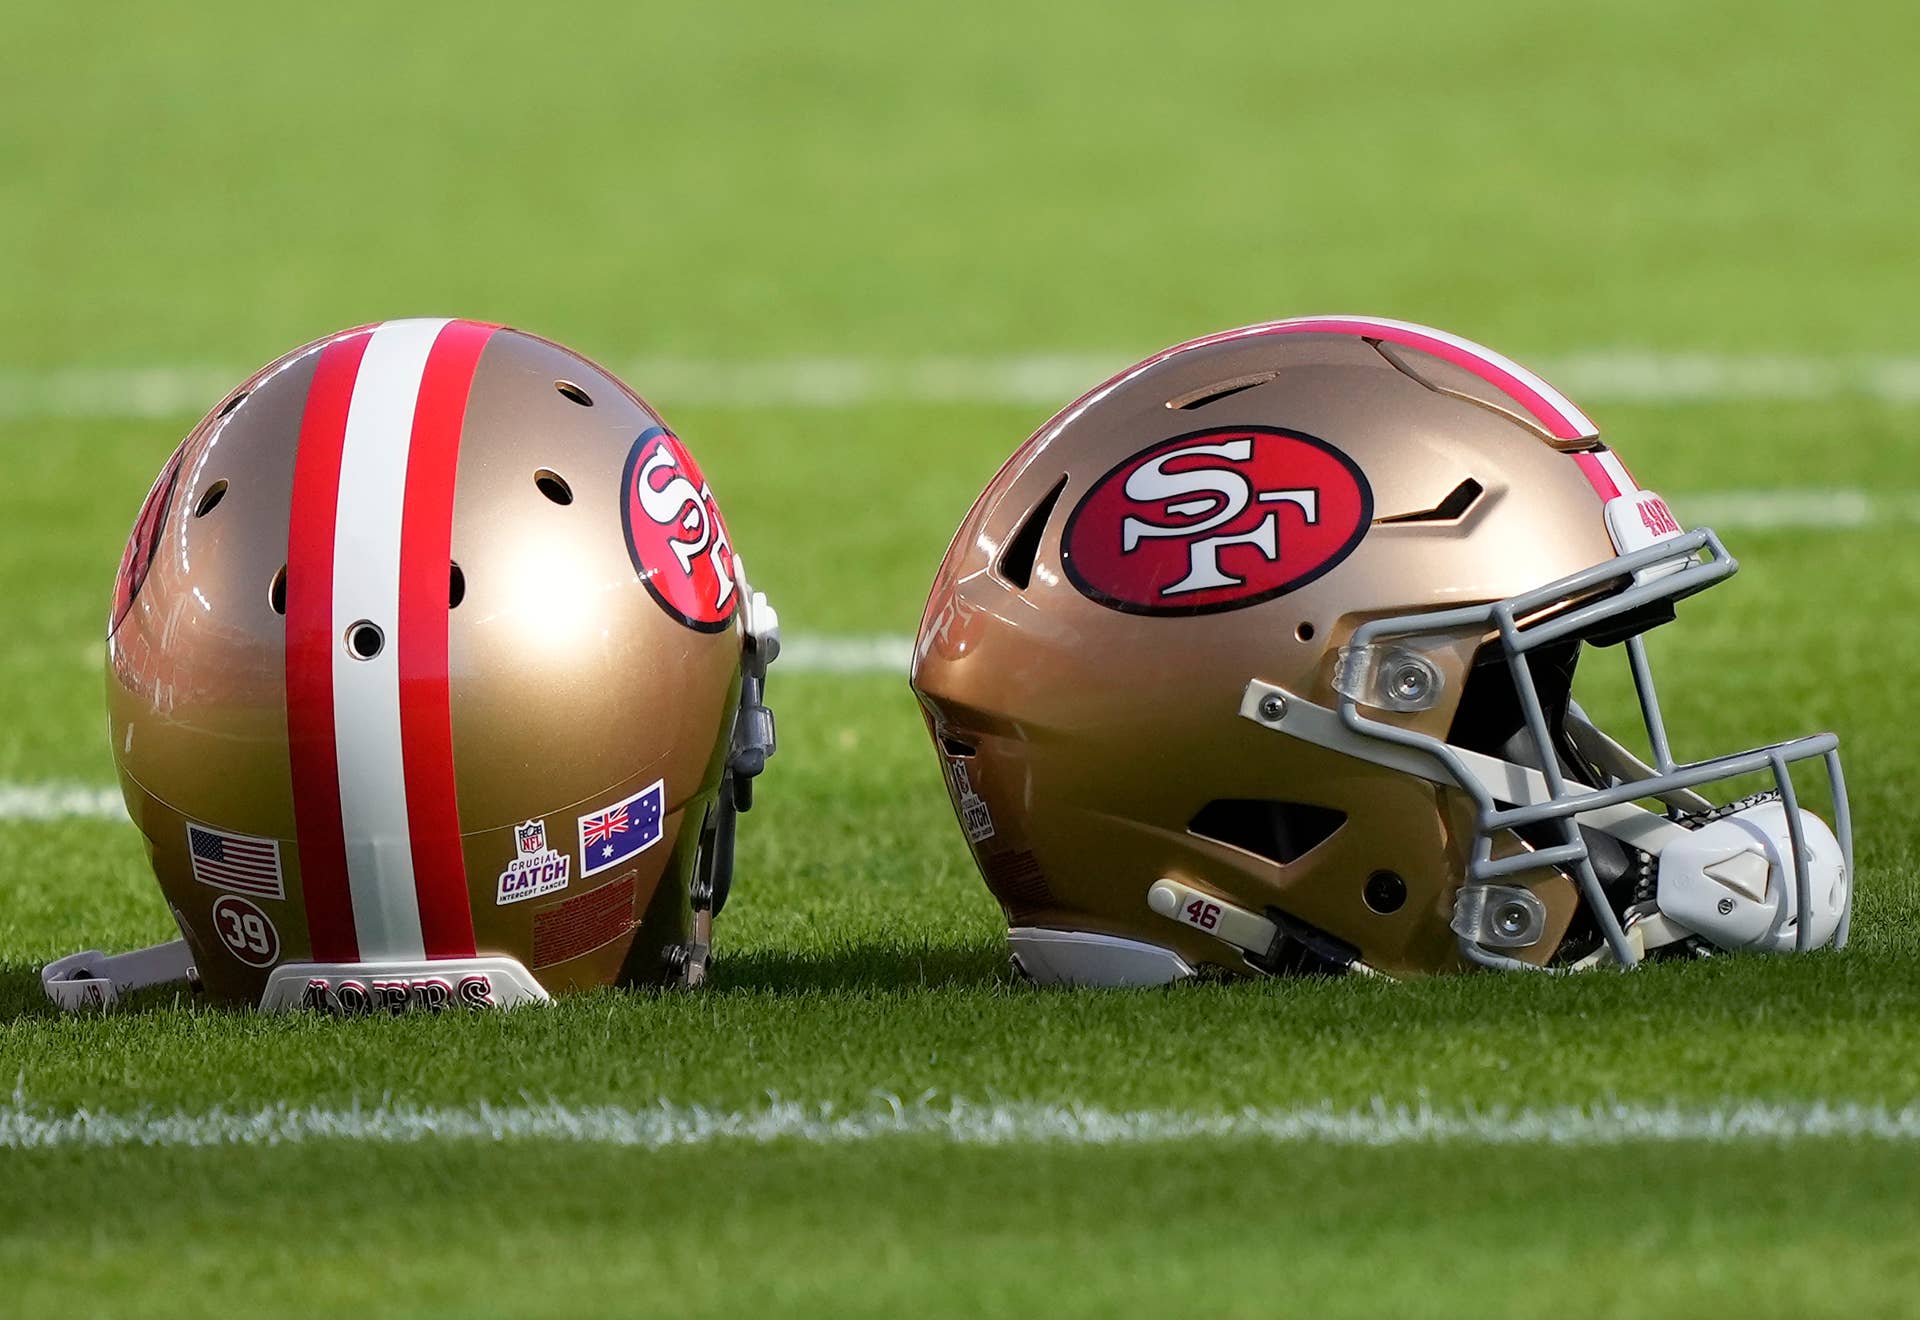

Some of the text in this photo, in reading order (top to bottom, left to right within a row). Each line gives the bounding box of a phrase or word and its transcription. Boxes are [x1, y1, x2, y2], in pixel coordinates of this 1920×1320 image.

[1123, 438, 1316, 596] SF
[522, 835, 543, 850] NFL
[502, 858, 567, 892] CATCH
[511, 852, 557, 871] CRUCIAL
[499, 879, 566, 902] INTERCEPT CANCER
[1186, 899, 1222, 930] 46
[220, 907, 270, 955] 39
